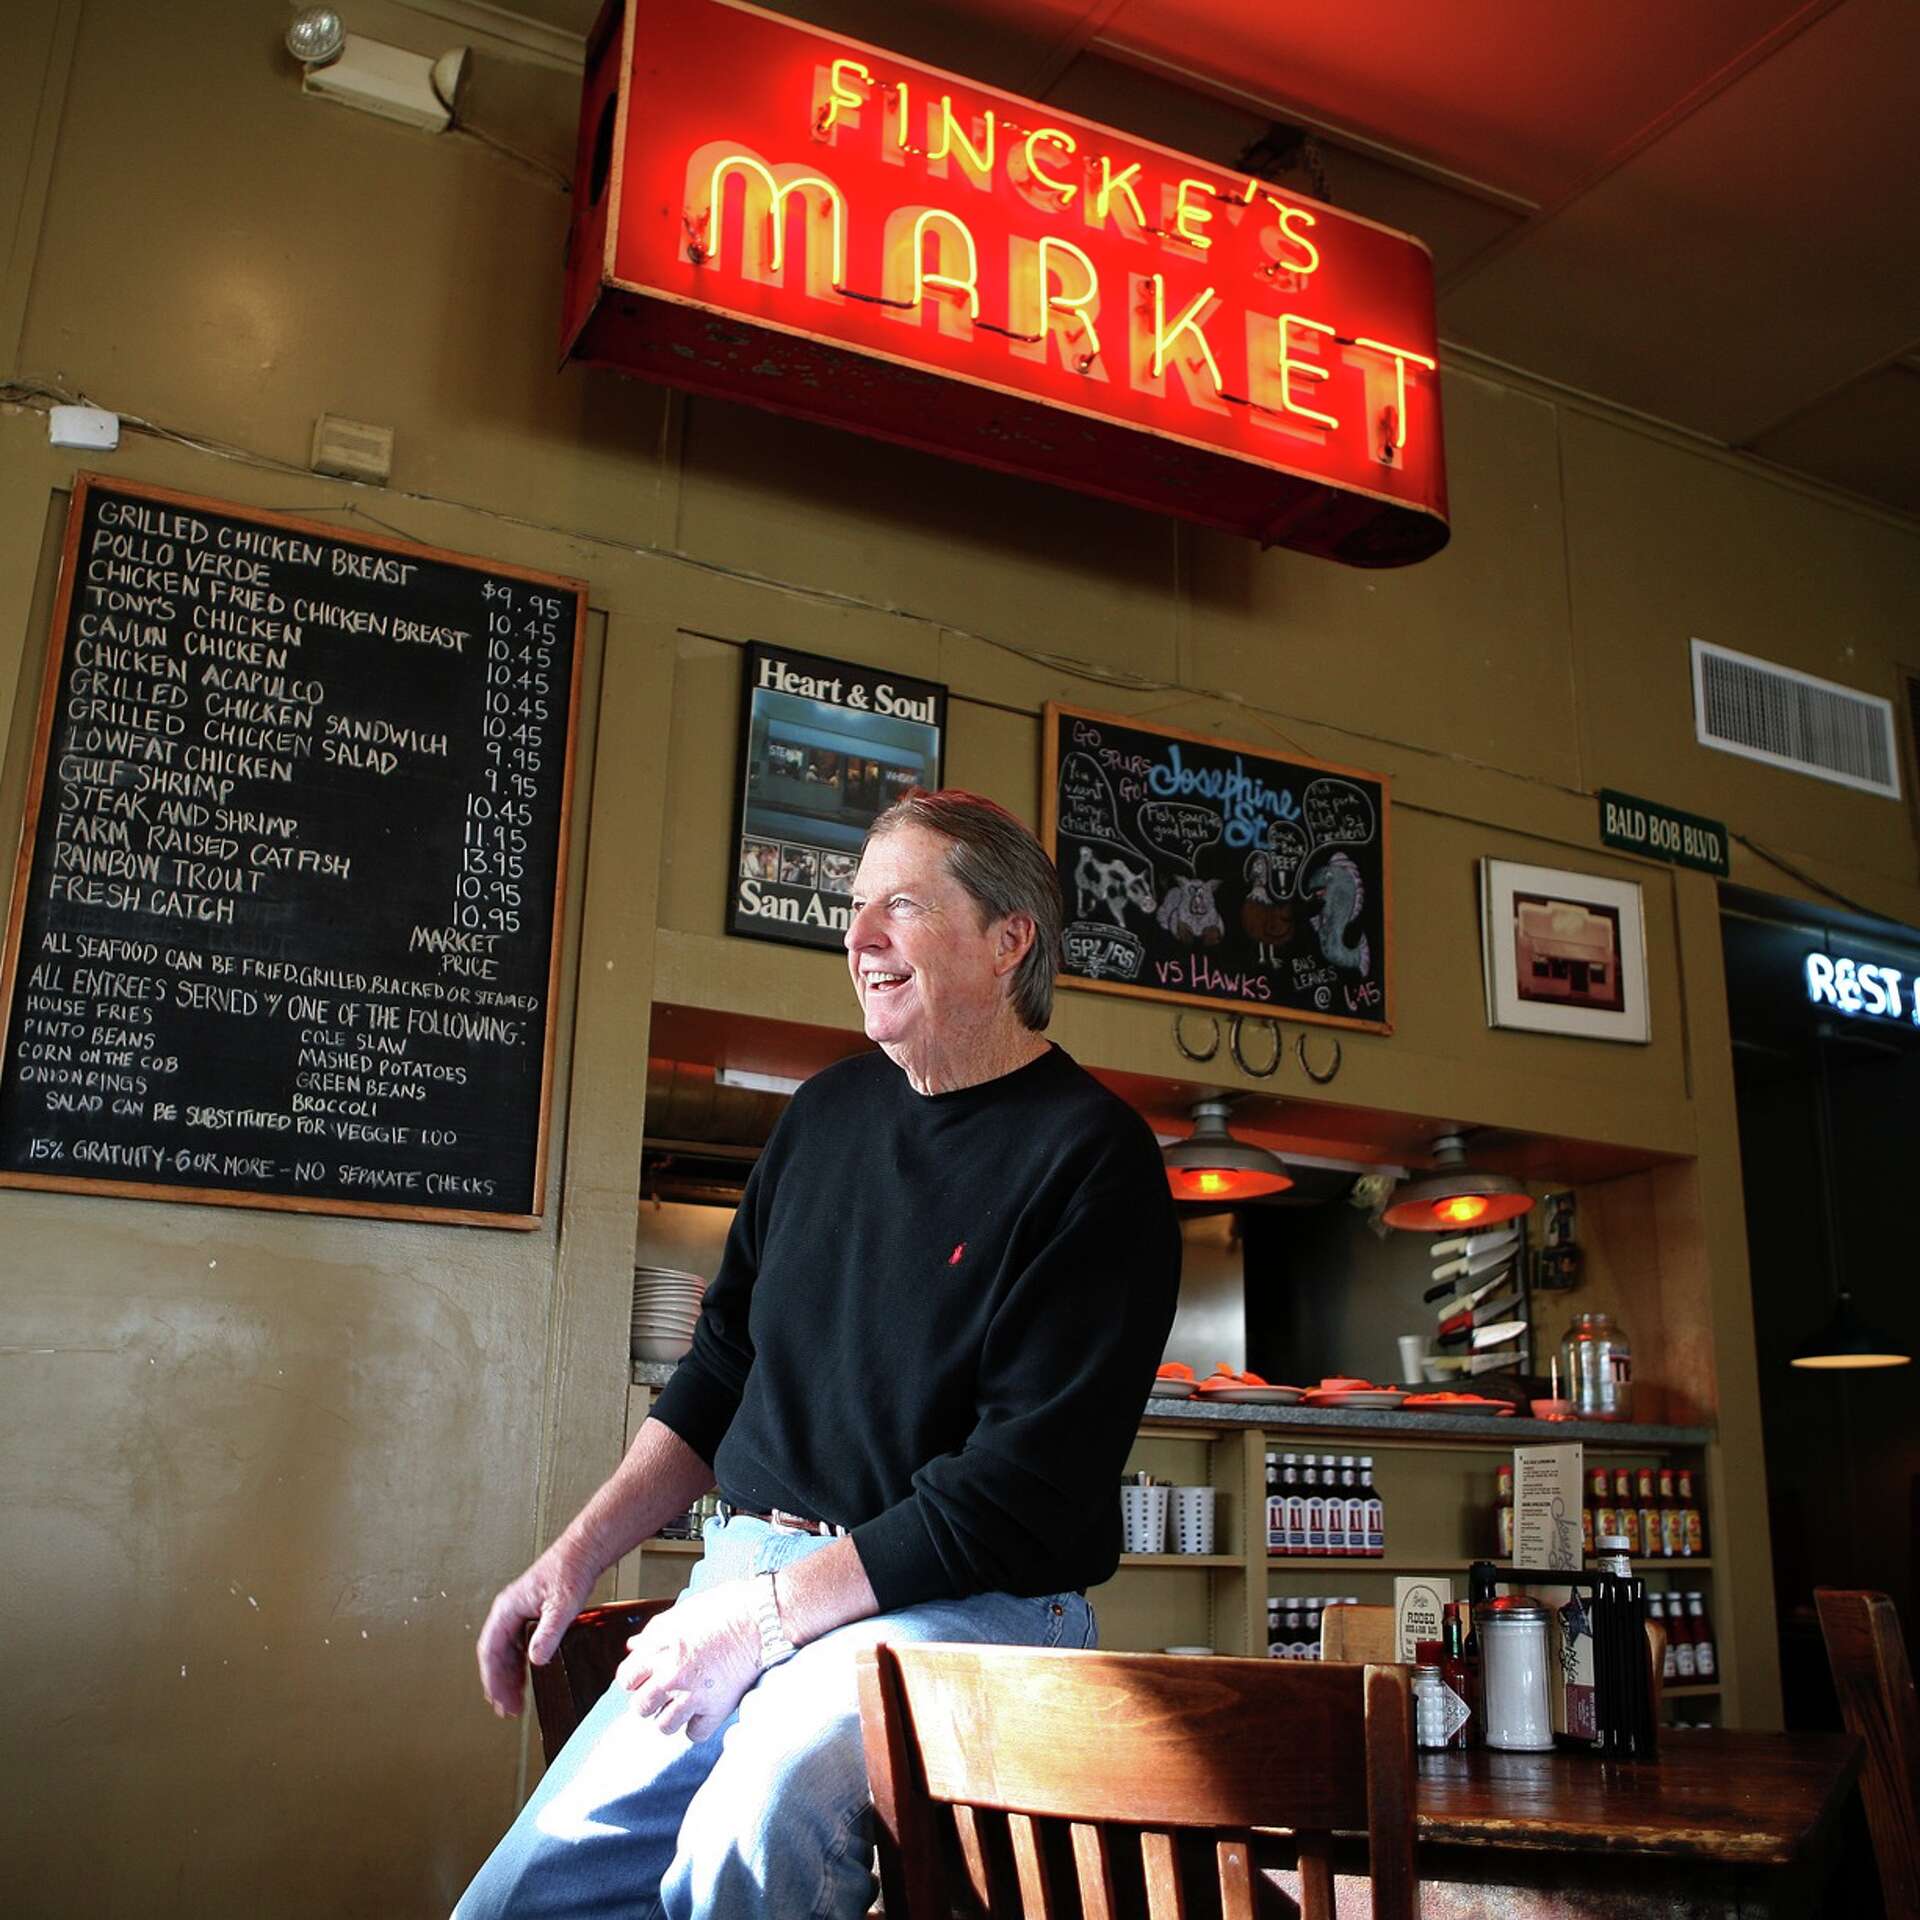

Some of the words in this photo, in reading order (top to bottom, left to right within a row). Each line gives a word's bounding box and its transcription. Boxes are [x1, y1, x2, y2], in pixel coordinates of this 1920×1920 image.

[810, 58, 1321, 294] FINCKE'S
[678, 139, 1437, 471] MARKET
[92, 530, 174, 566] POLLO
[187, 549, 272, 587] VERDE
[98, 501, 209, 544] GRILLED
[217, 527, 322, 566] CHICKEN
[332, 548, 418, 586] BREAST
[88, 560, 200, 597] CHICKEN
[210, 580, 286, 614] FRIED
[294, 598, 388, 637] CHICKEN
[393, 618, 473, 653] BREAST
[193, 605, 303, 647] CHICKEN
[80, 614, 167, 647] CAJUN
[184, 631, 287, 669] CHICKEN
[75, 640, 187, 683] CHICKEN
[201, 663, 324, 705] ACAPULCO
[759, 657, 842, 703] Heart
[847, 684, 870, 709] &
[875, 684, 935, 724] Soul
[68, 698, 185, 736] GRILLED
[203, 719, 313, 758] CHICKEN
[322, 739, 398, 775] SALAD
[70, 668, 188, 708] GRILLED
[205, 692, 313, 729] CHICKEN
[325, 715, 447, 756] SANDWICH
[58, 754, 125, 783] GULF
[134, 764, 234, 805] SHRIMP
[69, 725, 178, 764] LOWFAT
[184, 745, 292, 782] CHICKEN
[61, 783, 151, 824] STEAK
[157, 801, 209, 828] AND
[1149, 744, 1301, 820] Josephine
[55, 813, 131, 850] FARM
[147, 825, 239, 861] RAISED
[1606, 802, 1646, 842] BALD
[1650, 815, 1681, 851] BOB
[54, 842, 160, 883] RAINBOW
[172, 859, 266, 894] TROUT
[50, 875, 140, 912] FRESH
[151, 890, 235, 925] CATCH
[739, 880, 799, 922] San
[409, 925, 501, 953] MARKET
[1069, 938, 1136, 969] SPURS
[28, 962, 64, 993] ALL
[72, 968, 168, 1001] ENTREES
[176, 979, 258, 1016] SERVED
[288, 996, 330, 1025] ONE
[338, 1002, 360, 1026] OF
[365, 1003, 401, 1030] THE
[41, 932, 72, 953] ALL
[76, 935, 158, 964] SEAFOOD
[165, 949, 202, 970] CAN
[211, 955, 235, 974] BE
[447, 986, 472, 1005] OR
[475, 991, 539, 1011] STEAMED
[1806, 952, 1903, 1018] REST
[24, 1018, 85, 1039] PINTO
[91, 1027, 156, 1051] BEANS
[27, 995, 86, 1017] HOUSE
[96, 1003, 153, 1025] FRIES
[18, 1041, 72, 1062] CORN
[80, 1049, 103, 1063] ON
[104, 1051, 133, 1068] THE
[140, 1056, 179, 1073] COB
[298, 1049, 373, 1073] MASHED
[379, 1059, 468, 1086] POTATOES
[301, 1029, 346, 1048] COLE
[356, 1033, 407, 1056] SLAW
[292, 1093, 378, 1117] BROCCOLI
[296, 1072, 361, 1093] GREEN
[366, 1079, 427, 1100] BEANS
[46, 1091, 103, 1113] SALAD
[111, 1098, 144, 1116] CAN
[153, 1102, 178, 1122] BE
[185, 1106, 292, 1130] SUBSTITUTED
[297, 1117, 326, 1136] FOR
[335, 1123, 410, 1145] VEGGIE
[29, 1138, 65, 1160] 15%
[223, 1156, 275, 1179] MORE
[295, 1162, 325, 1181] NO
[338, 1165, 422, 1189] SEPARATE
[425, 1173, 497, 1196] CHECKS
